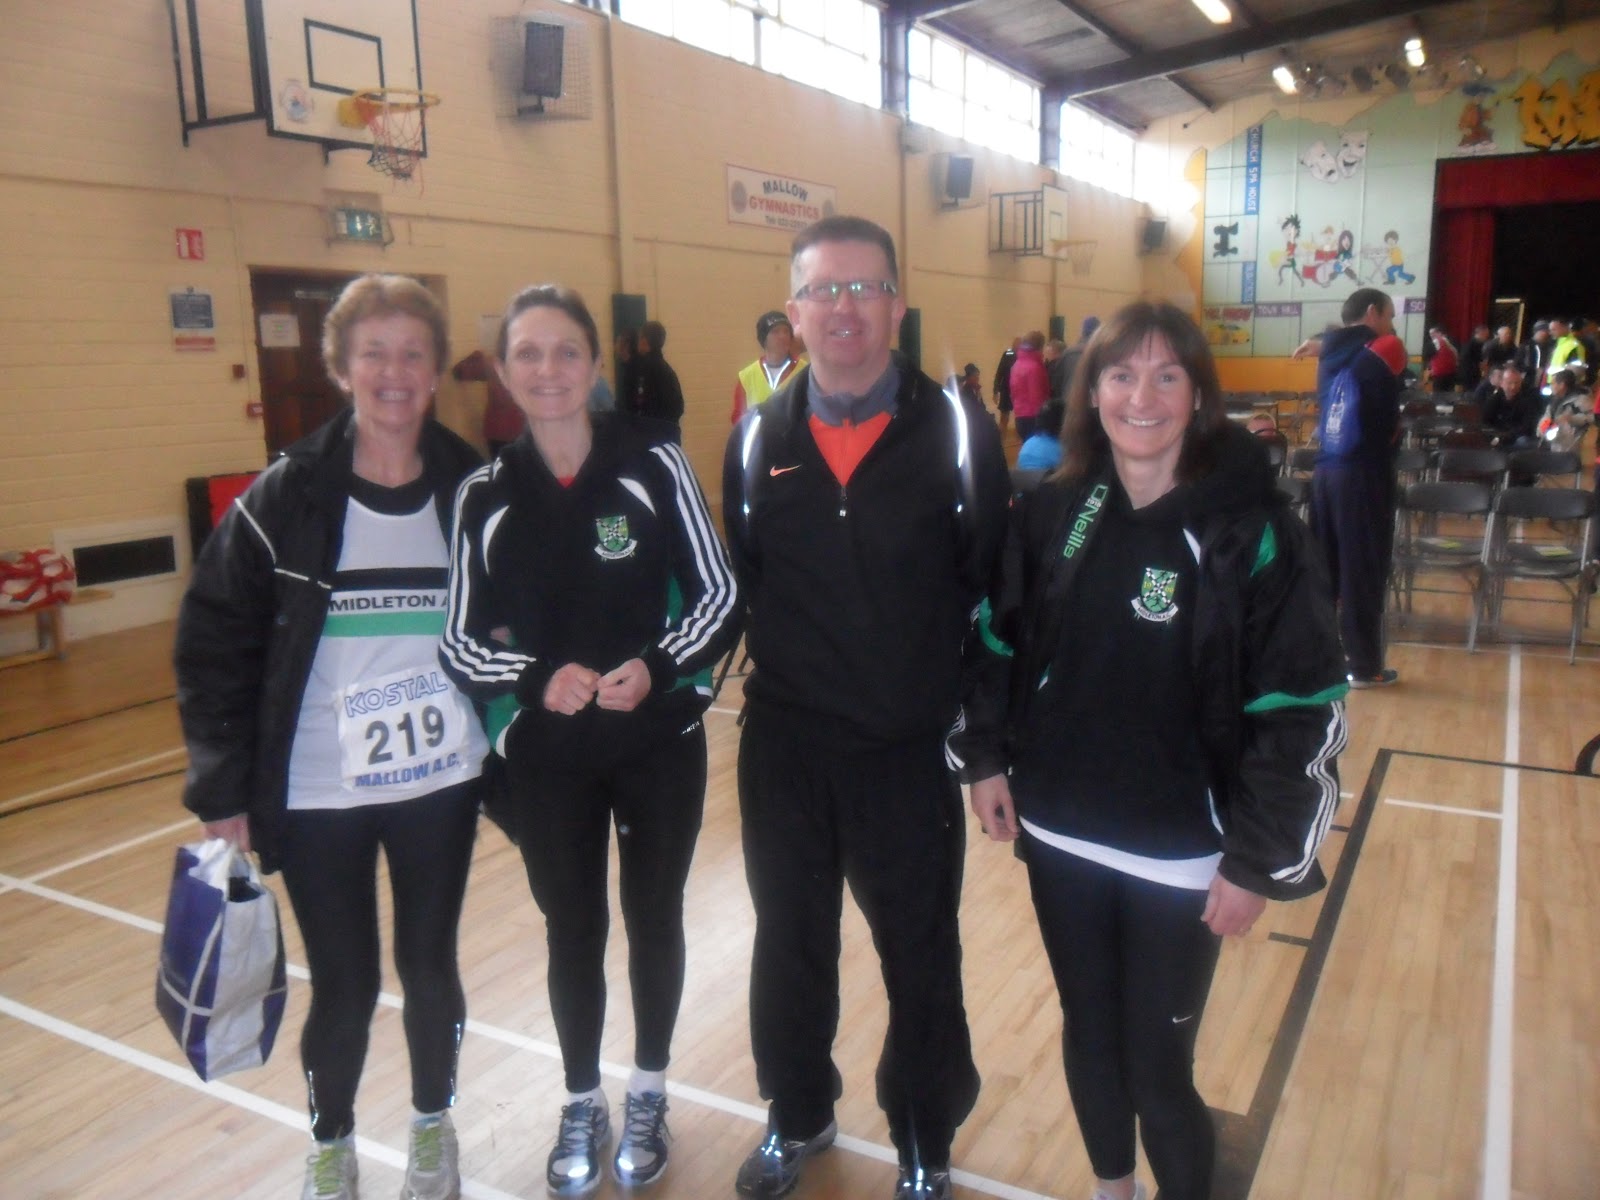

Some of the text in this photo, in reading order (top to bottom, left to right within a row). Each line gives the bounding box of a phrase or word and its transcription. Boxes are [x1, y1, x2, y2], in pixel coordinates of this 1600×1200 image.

[1247, 127, 1259, 212] CHURCH SPA HOUSE
[762, 180, 808, 202] MALLOW
[749, 196, 820, 220] GYMNASTICS
[1258, 303, 1300, 314] TOWN HALL
[330, 595, 436, 612] MIDLETON
[344, 672, 448, 717] KOSTAL
[365, 705, 445, 765] 219
[355, 752, 460, 787] MALLOW A.C.
